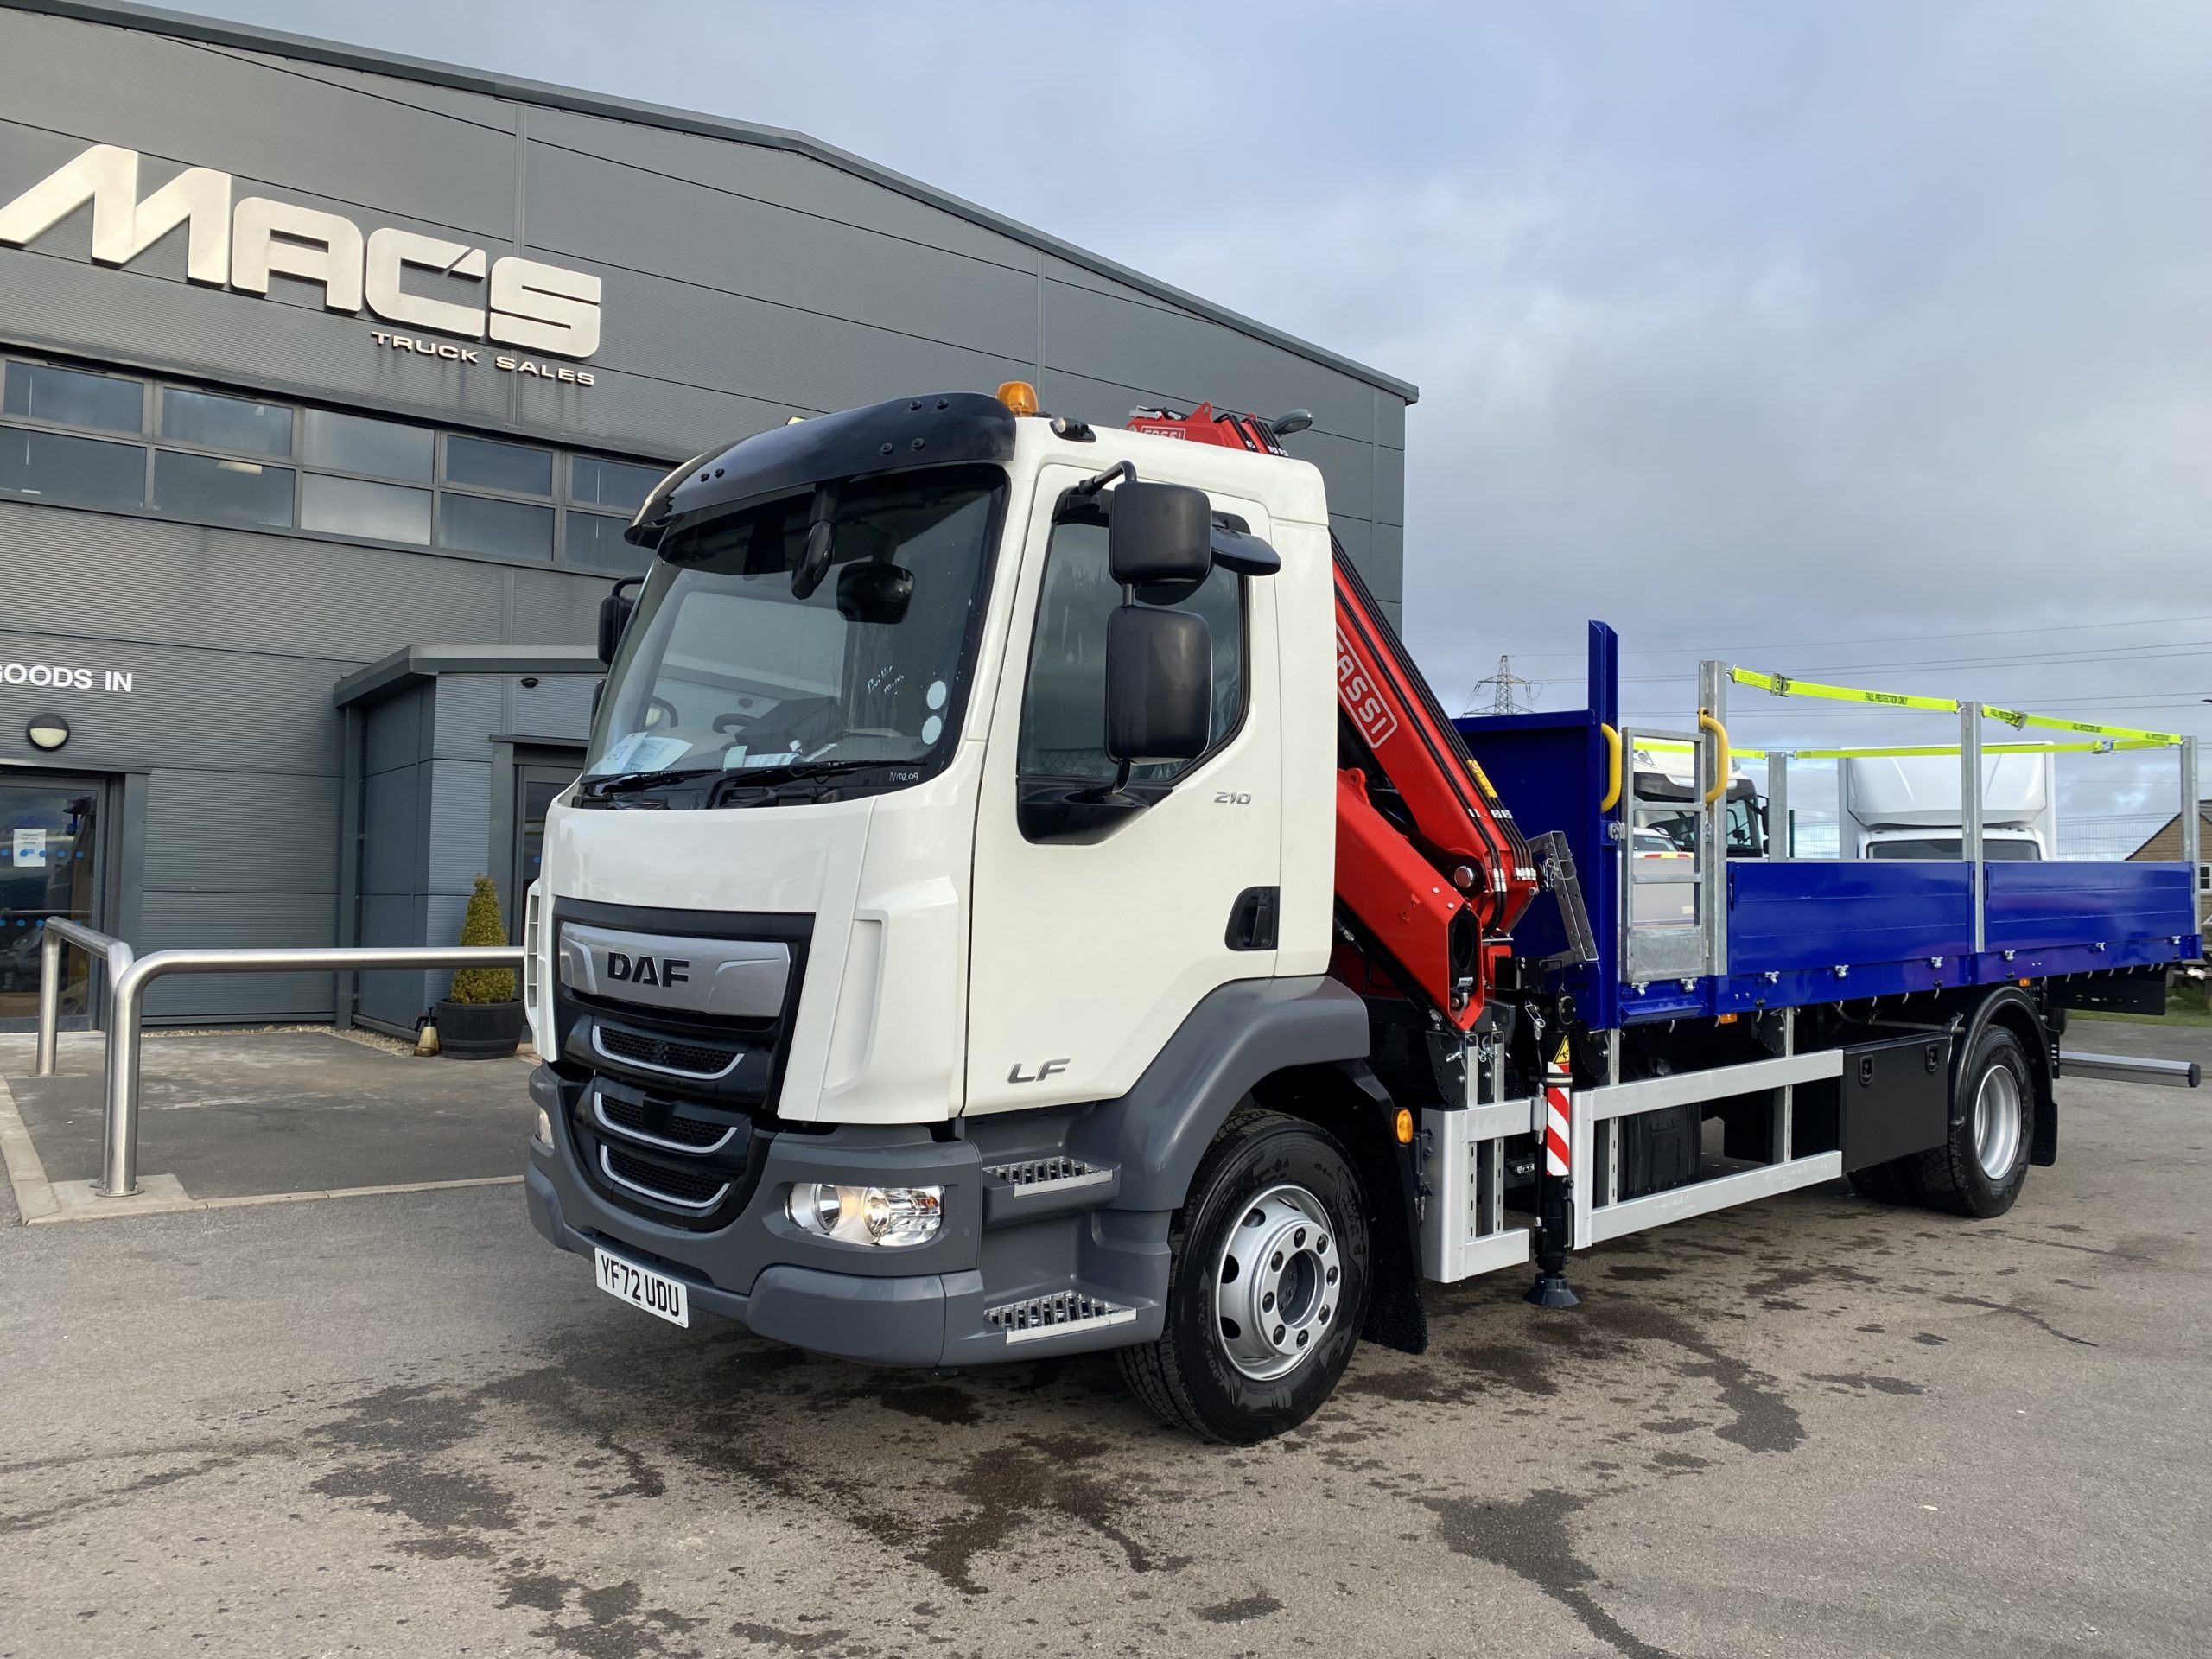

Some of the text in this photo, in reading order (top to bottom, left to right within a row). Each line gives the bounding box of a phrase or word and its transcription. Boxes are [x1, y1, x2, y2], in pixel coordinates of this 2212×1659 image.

[0, 143, 602, 359] MACS
[372, 331, 595, 386] TRUCK SALES
[0, 664, 132, 692] OODS IN
[1336, 636, 1387, 734] ASSI
[1213, 791, 1252, 804] 210
[607, 950, 690, 988] DAF
[1007, 1058, 1071, 1084] LF
[601, 1255, 680, 1318] YF72 UDU
